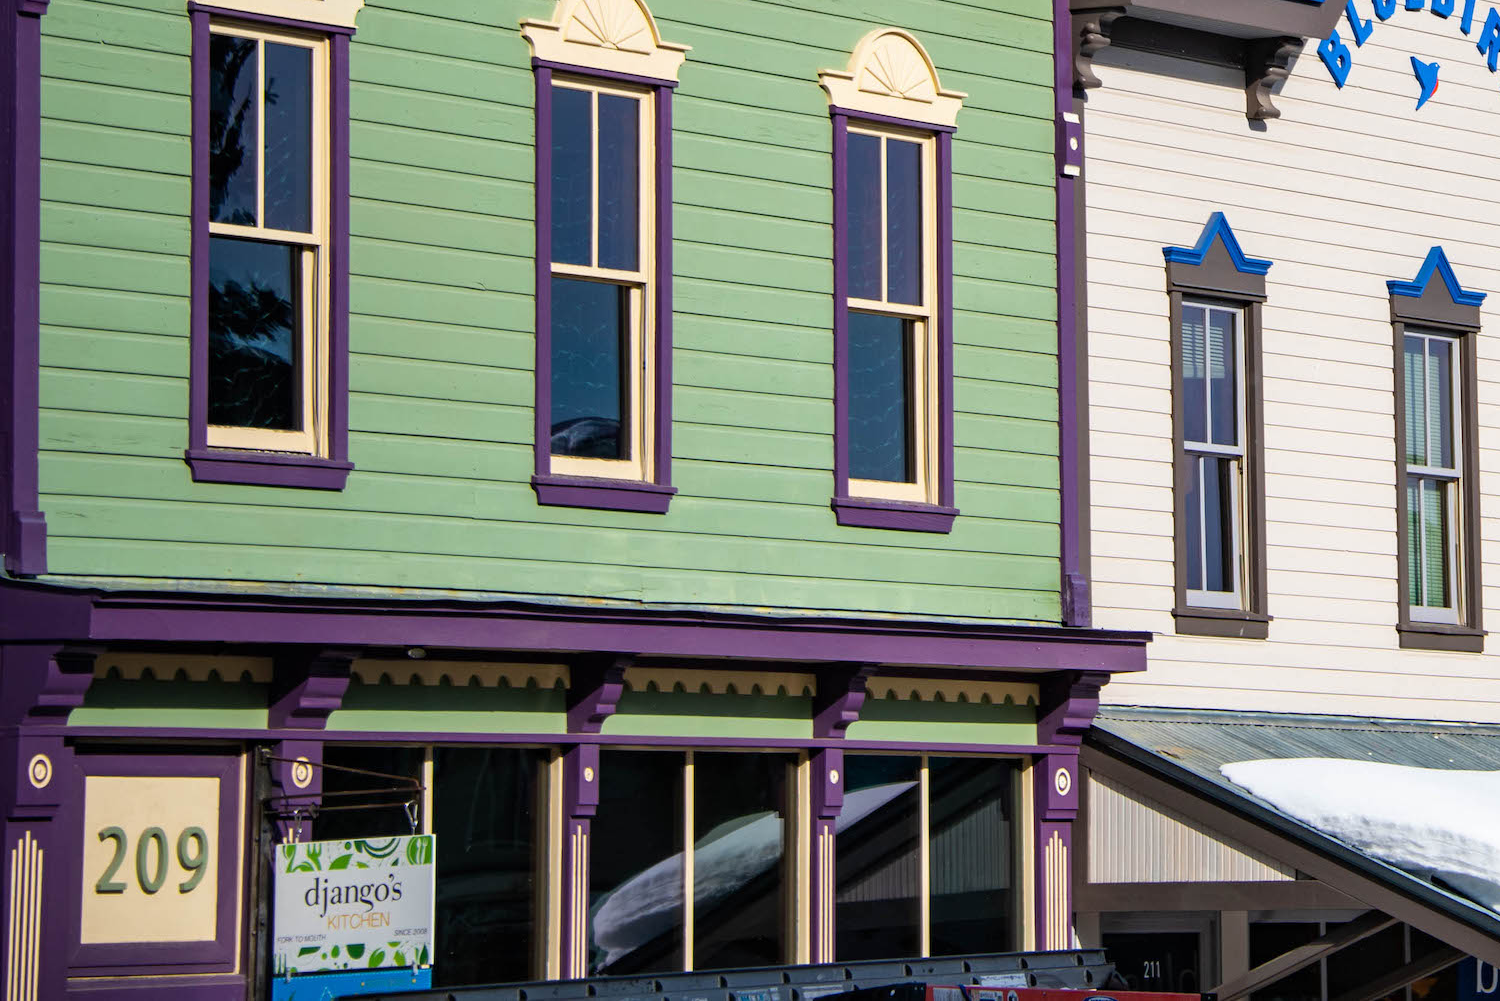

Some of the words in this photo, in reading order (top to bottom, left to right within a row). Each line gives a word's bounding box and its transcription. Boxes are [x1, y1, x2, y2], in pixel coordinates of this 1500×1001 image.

[95, 826, 209, 895] 209
[304, 873, 403, 918] django's
[327, 912, 390, 930] KITCHEN
[295, 935, 304, 943] TO
[394, 928, 413, 936] SINCE
[1143, 961, 1160, 979] 211
